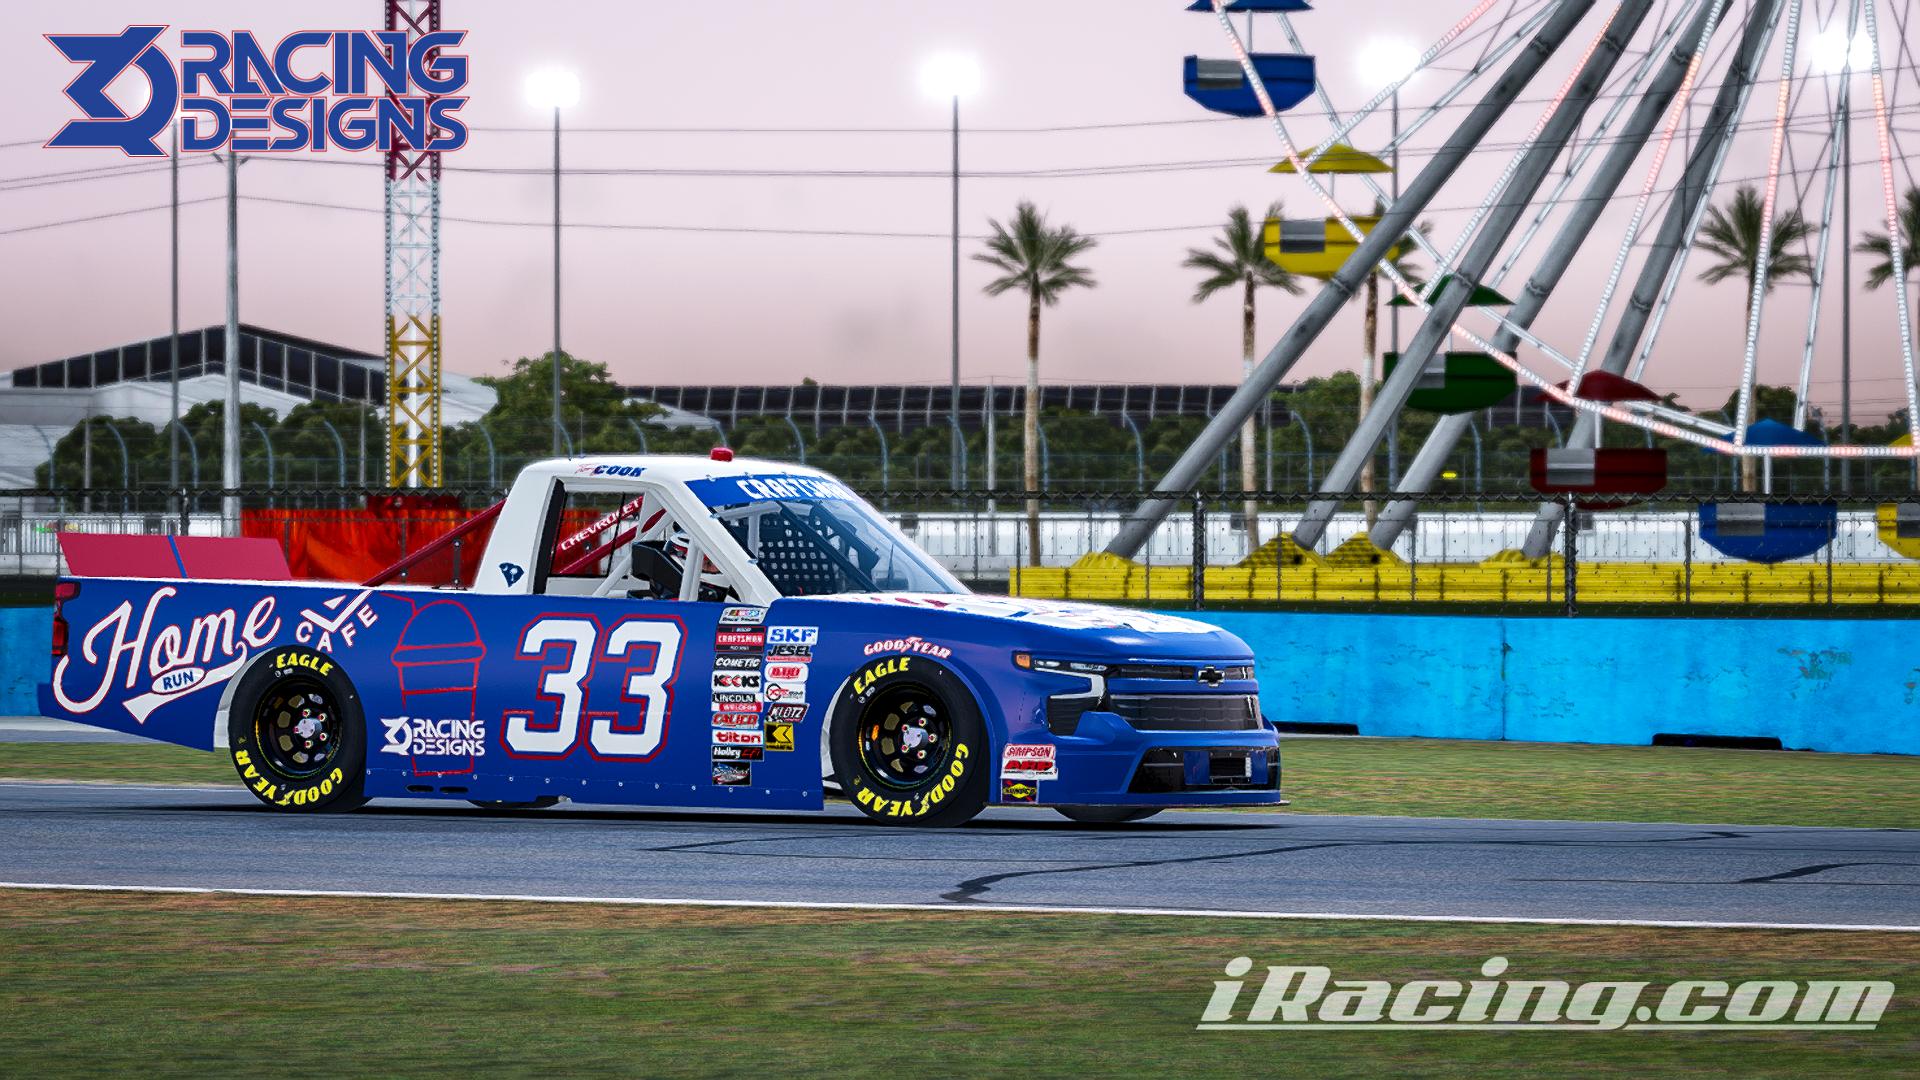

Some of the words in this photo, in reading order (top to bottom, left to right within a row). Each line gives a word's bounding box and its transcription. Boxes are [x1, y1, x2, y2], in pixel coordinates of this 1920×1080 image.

[593, 464, 647, 477] COOK
[296, 604, 379, 653] CAFE
[769, 628, 817, 643] SKF
[718, 634, 763, 643] CRAFTSMAN
[53, 586, 281, 713] Home
[276, 652, 334, 677] EAGLE
[715, 656, 761, 668] COMETIC
[163, 670, 195, 690] RUN
[853, 656, 911, 695] EAGLE
[501, 613, 688, 762] 33
[713, 693, 754, 703] LINCOLN
[770, 706, 804, 719] KLOTZ
[413, 718, 486, 739] RACING
[413, 738, 486, 757] DESIGNS
[713, 746, 741, 759] Holley
[1006, 746, 1052, 757] SIMPSON
